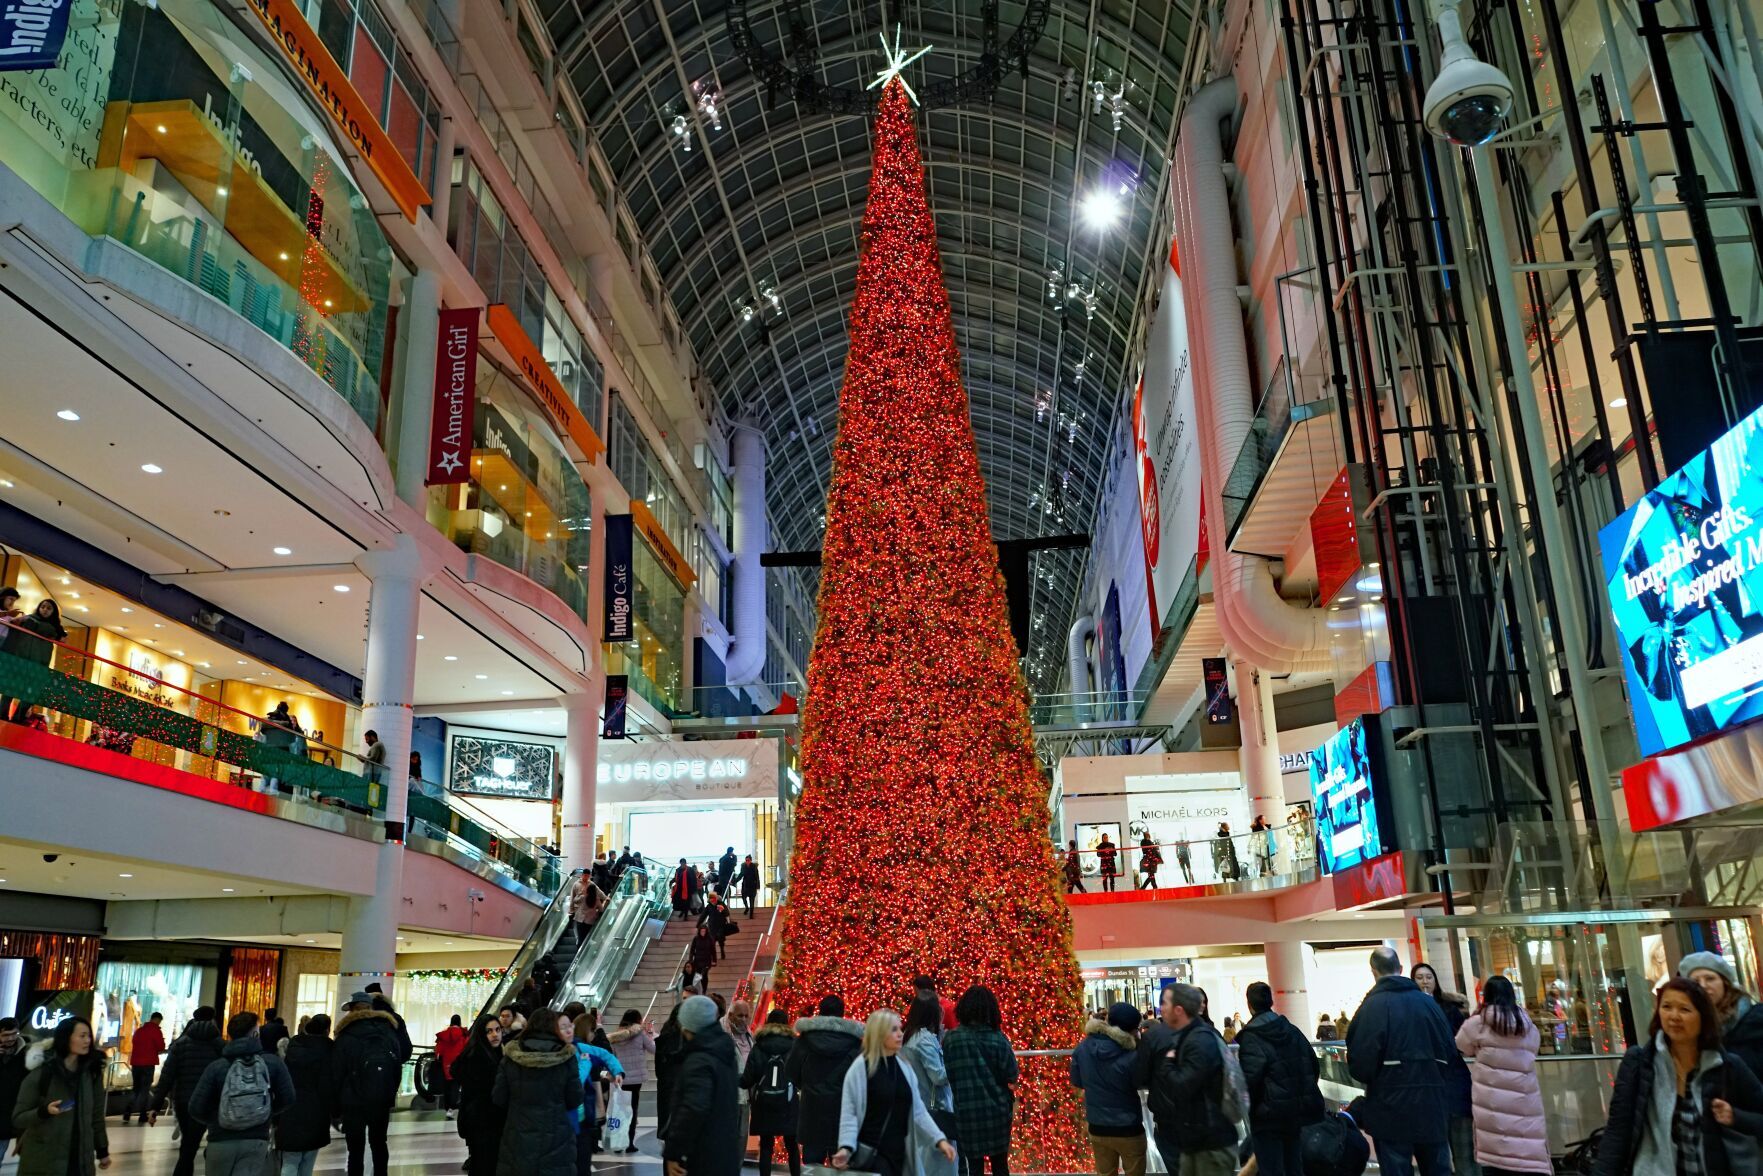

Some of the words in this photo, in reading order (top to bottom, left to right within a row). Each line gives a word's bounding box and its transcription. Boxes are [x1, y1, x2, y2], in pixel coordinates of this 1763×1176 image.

[61, 97, 91, 130] able
[442, 360, 466, 447] American
[522, 356, 570, 426] CREATIVITY
[613, 563, 627, 595] Café
[1672, 542, 1745, 612] Inspired
[609, 597, 629, 637] Indigo
[597, 759, 746, 783] EUROPEAN
[695, 782, 742, 790] BOUTIQUE
[1141, 809, 1192, 820] MICHAEL
[1196, 807, 1228, 818] KORS
